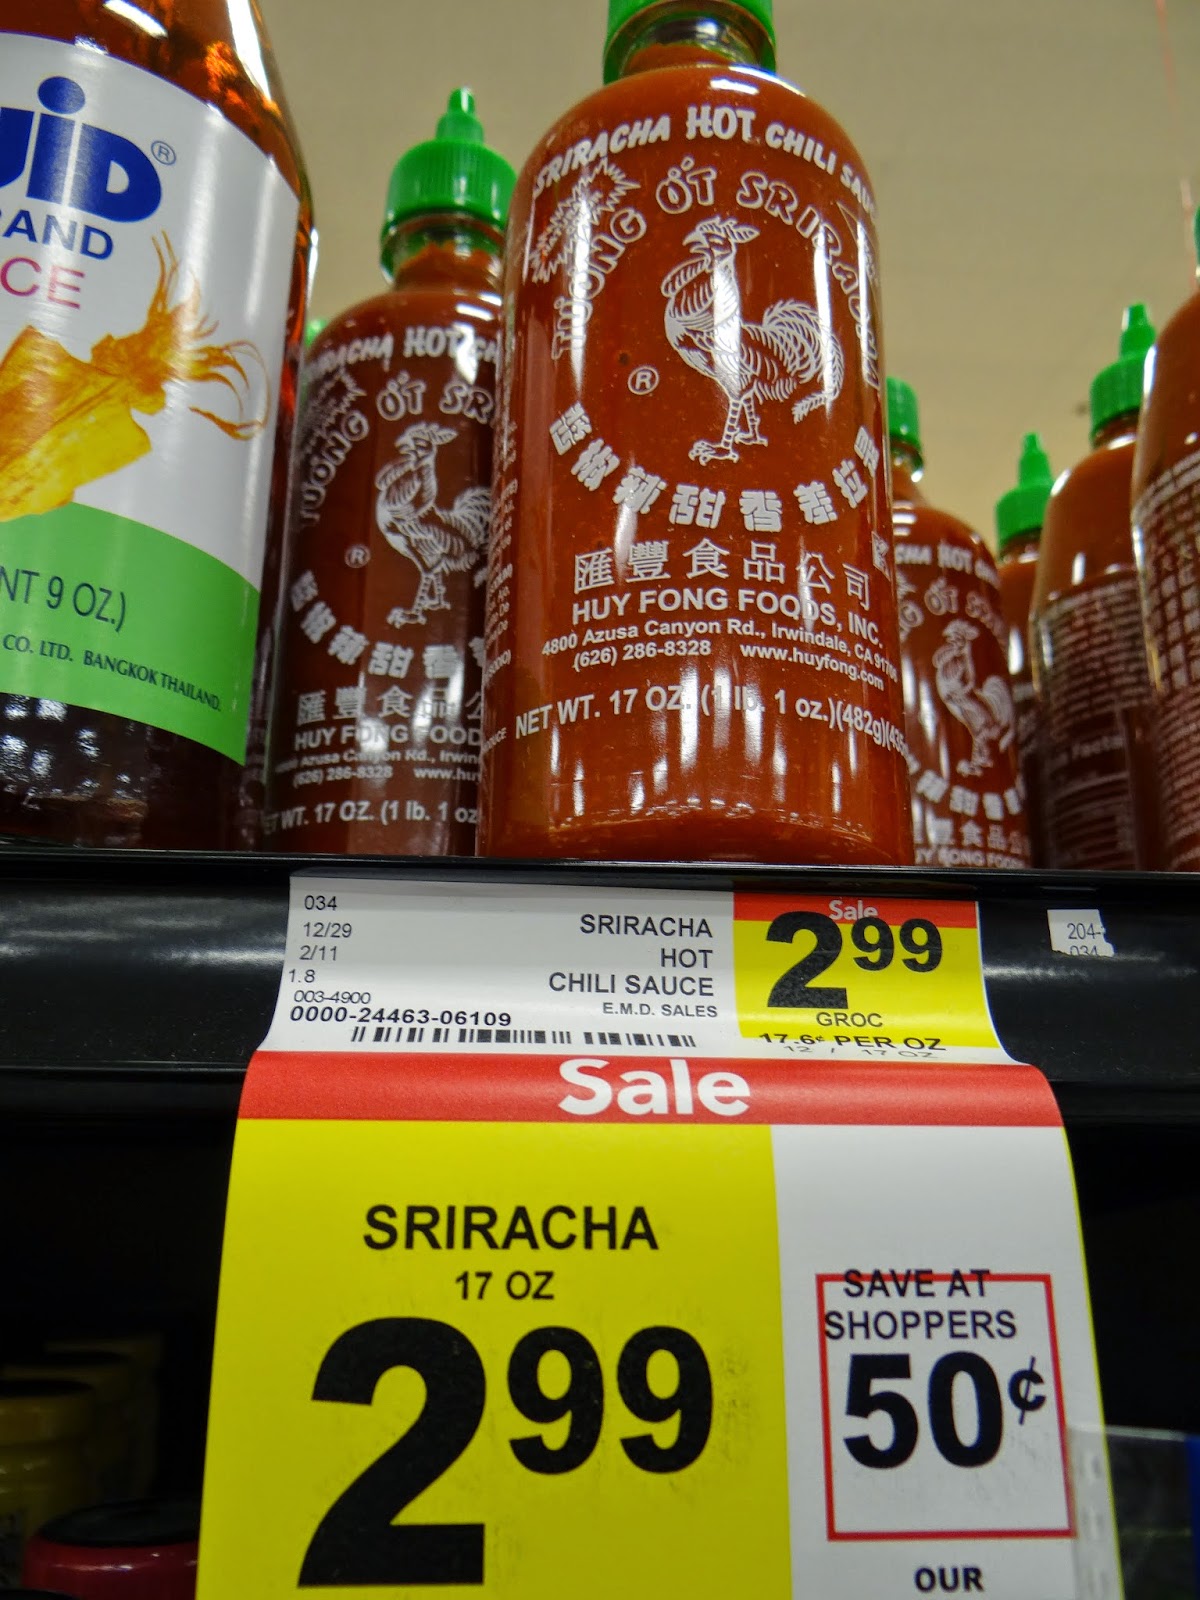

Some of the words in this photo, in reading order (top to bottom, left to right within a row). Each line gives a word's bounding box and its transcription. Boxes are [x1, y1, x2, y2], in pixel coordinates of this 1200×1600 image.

[533, 113, 671, 200] SRIRACHA
[686, 104, 757, 143] HOT
[765, 121, 838, 175] CHILI
[0, 208, 113, 260] AND
[48, 576, 64, 610] 9
[73, 582, 127, 633] OZ.)
[572, 591, 631, 626] HUY
[639, 588, 728, 614] FONG
[738, 588, 843, 633] FOODS,
[848, 611, 884, 649] INC.
[541, 632, 578, 656] 4800
[582, 628, 639, 646] Azusa
[644, 619, 721, 638] Canyon
[727, 617, 766, 640] Rd.,
[771, 621, 851, 657] Irwindale,
[854, 643, 874, 666] CA
[3, 634, 33, 654] CO.
[40, 640, 73, 662] LTD.
[84, 650, 157, 687] BANGKOK
[160, 672, 222, 712] THAILAND.
[572, 645, 618, 673] (626)
[623, 639, 712, 661] 286-8328
[740, 643, 885, 691] www.huyfong.com
[515, 704, 553, 740] NET
[557, 693, 601, 725] WT.
[609, 688, 638, 716] 17
[645, 685, 692, 712] OZ.
[774, 689, 786, 715] 1
[295, 727, 337, 752] HUY
[414, 724, 482, 747] OOD
[281, 805, 309, 830] WT.
[314, 802, 336, 823] 17
[339, 800, 374, 822] OZ.
[405, 800, 431, 821] lb.
[304, 895, 338, 911] 034
[828, 899, 879, 921] Sale
[303, 921, 353, 938] 12/29
[580, 914, 713, 938] SRIRACHA
[299, 945, 338, 961] 2/11
[660, 947, 713, 969] HOT
[293, 989, 372, 1005] 003-4900
[549, 971, 616, 994] CHILI
[624, 974, 714, 997] SAUCE
[290, 1005, 512, 1027] 0000-24463-06109
[602, 1002, 655, 1016] E.M.D.
[661, 1003, 718, 1018] SALES
[816, 1011, 883, 1028] GROC
[834, 1035, 897, 1049] PER
[903, 1037, 947, 1051] OZ
[558, 1058, 750, 1117] Sale
[363, 1204, 659, 1251] SRIRACHA
[455, 1271, 493, 1301] 17
[506, 1270, 555, 1301] OZ
[843, 1269, 936, 1298] SAVE
[947, 1269, 991, 1298] AT
[824, 1310, 1017, 1340] SHOPPERS
[914, 1565, 985, 1593] OUR
